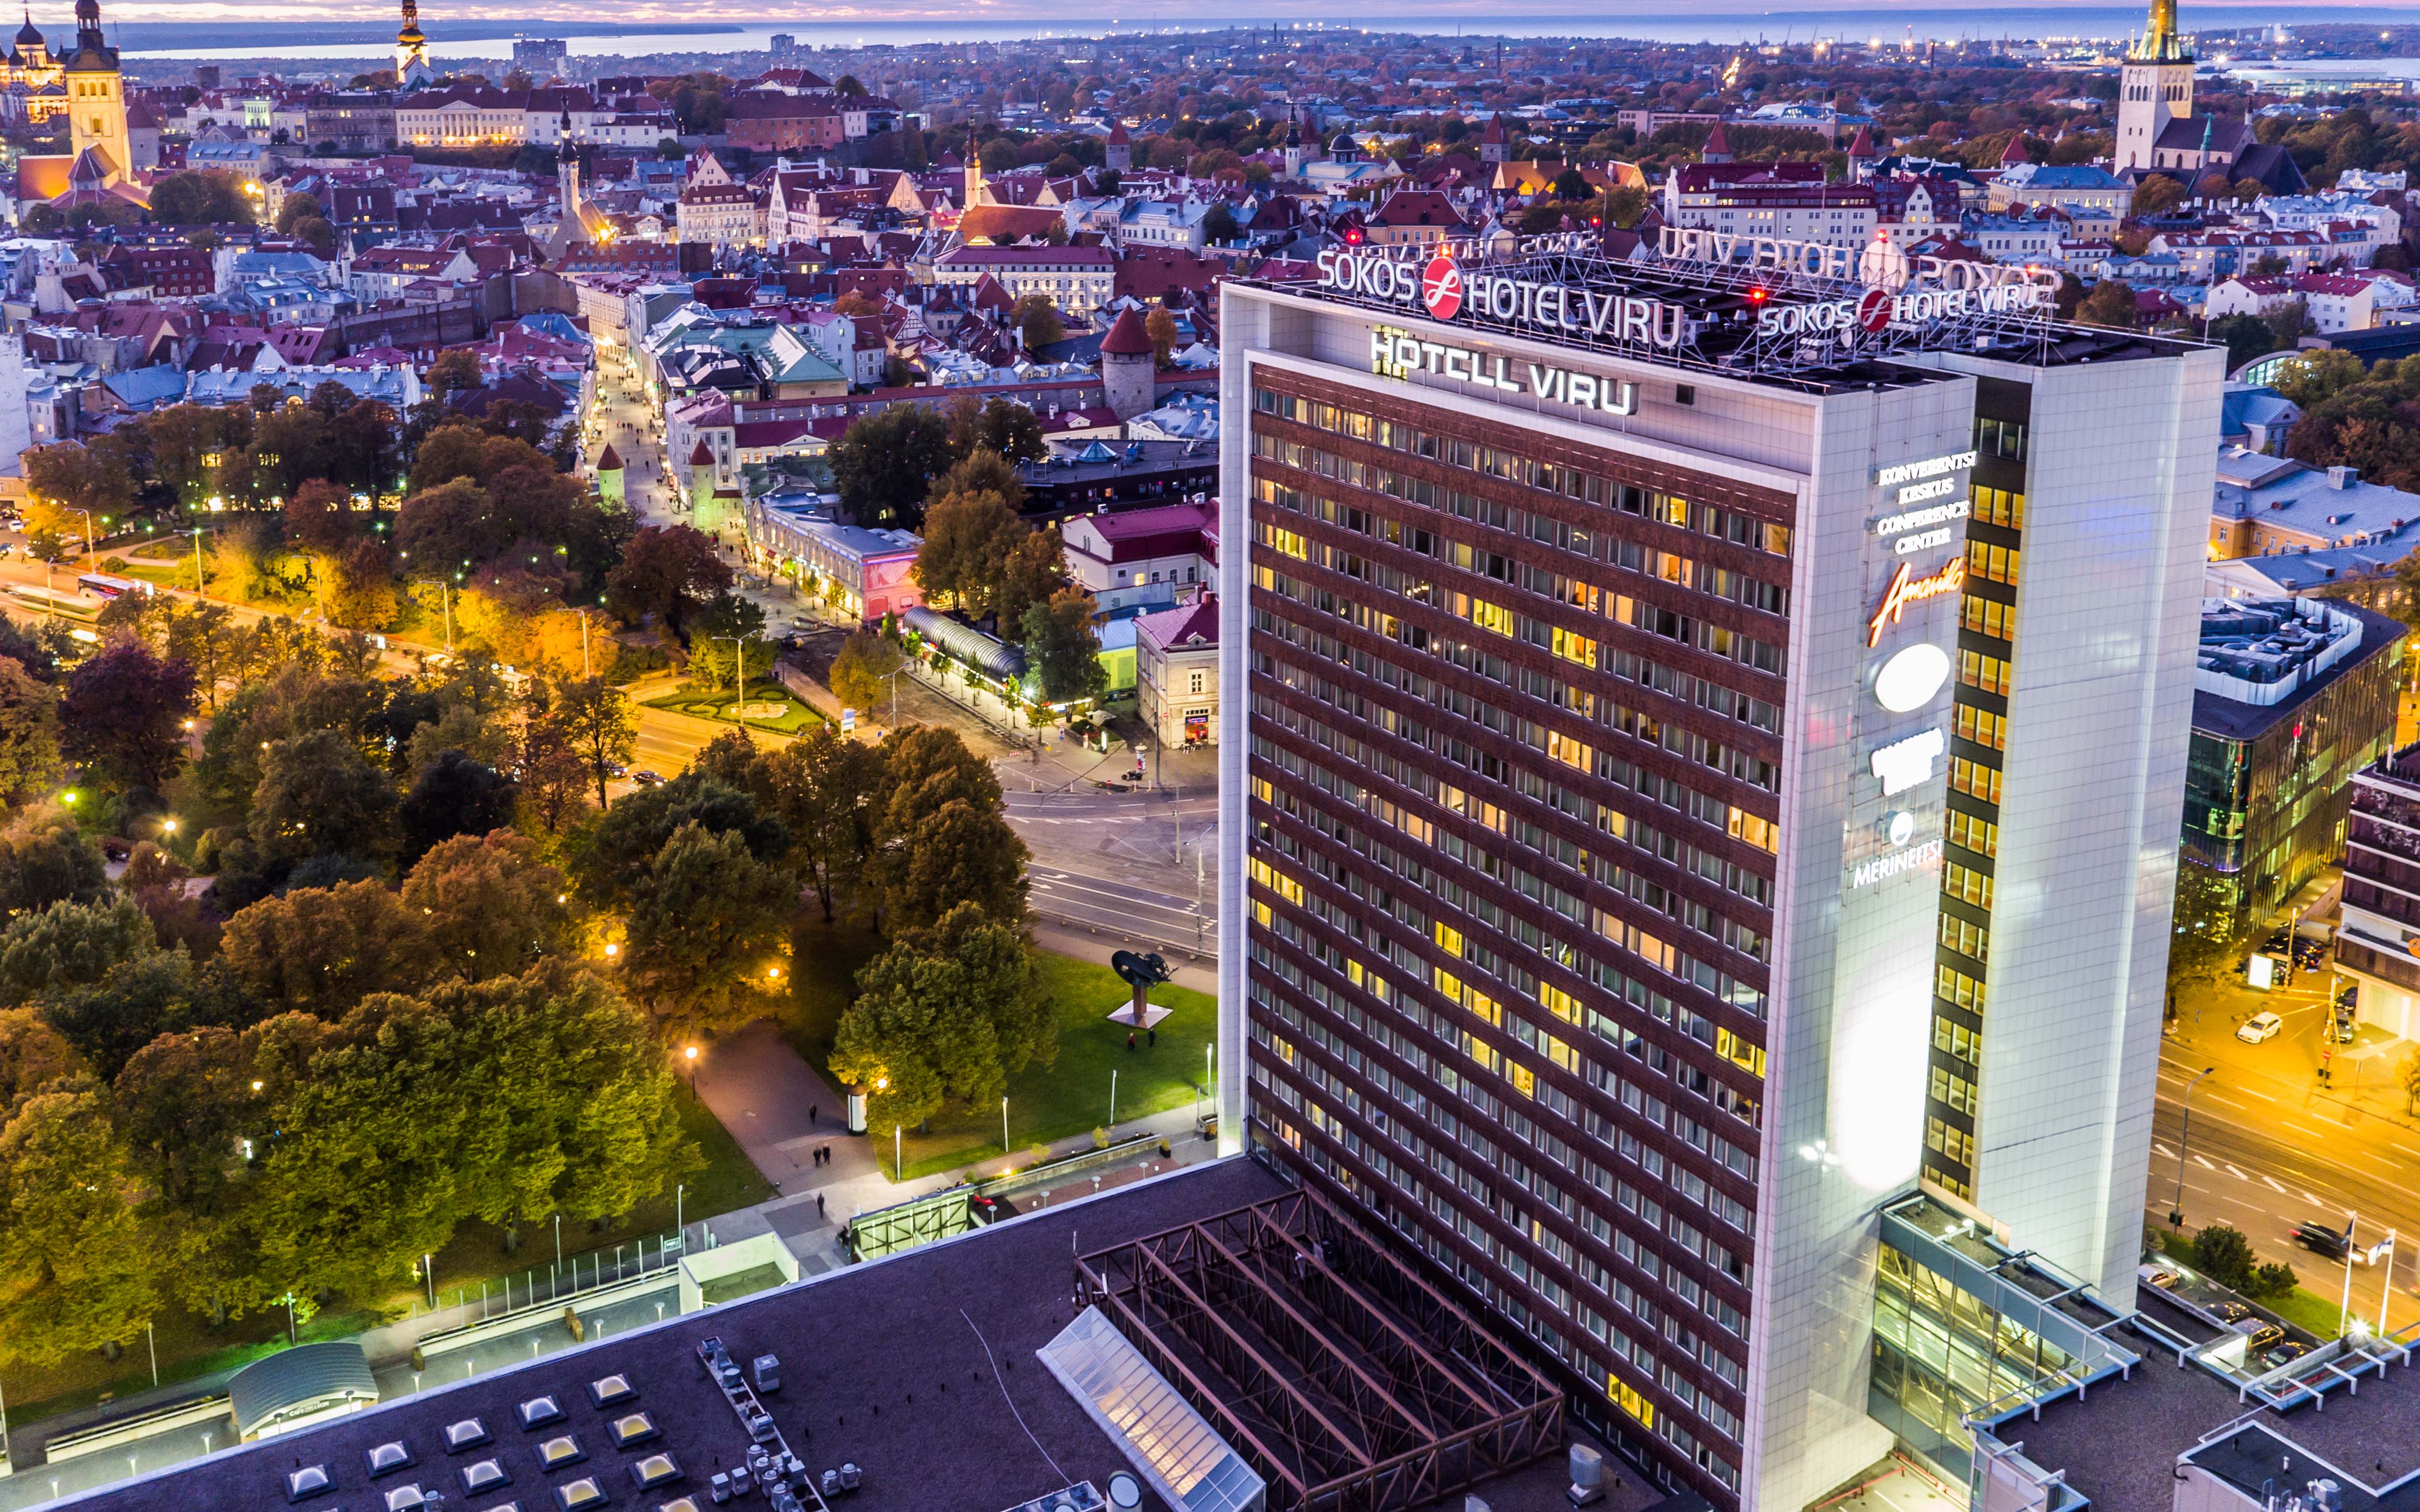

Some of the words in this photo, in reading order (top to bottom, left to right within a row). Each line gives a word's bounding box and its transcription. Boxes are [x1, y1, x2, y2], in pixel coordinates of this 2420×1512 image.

[1317, 250, 1417, 301] SOKOS
[1468, 273, 1578, 330] HOTEL
[1582, 291, 1684, 347] VIRU
[1758, 300, 1855, 337] SOKOS
[1896, 289, 1975, 322] HOTEL
[1977, 282, 2039, 313] VIRU
[1528, 363, 1639, 416] VIRU
[1878, 451, 1977, 486] KONVERENTSI
[1898, 478, 1955, 505] KESKUS
[1877, 500, 1970, 536] CONFERENCE
[1895, 528, 1951, 555] CENTER
[1868, 557, 1965, 649] Amarillo
[1853, 838, 1943, 889] MERINEITSI
